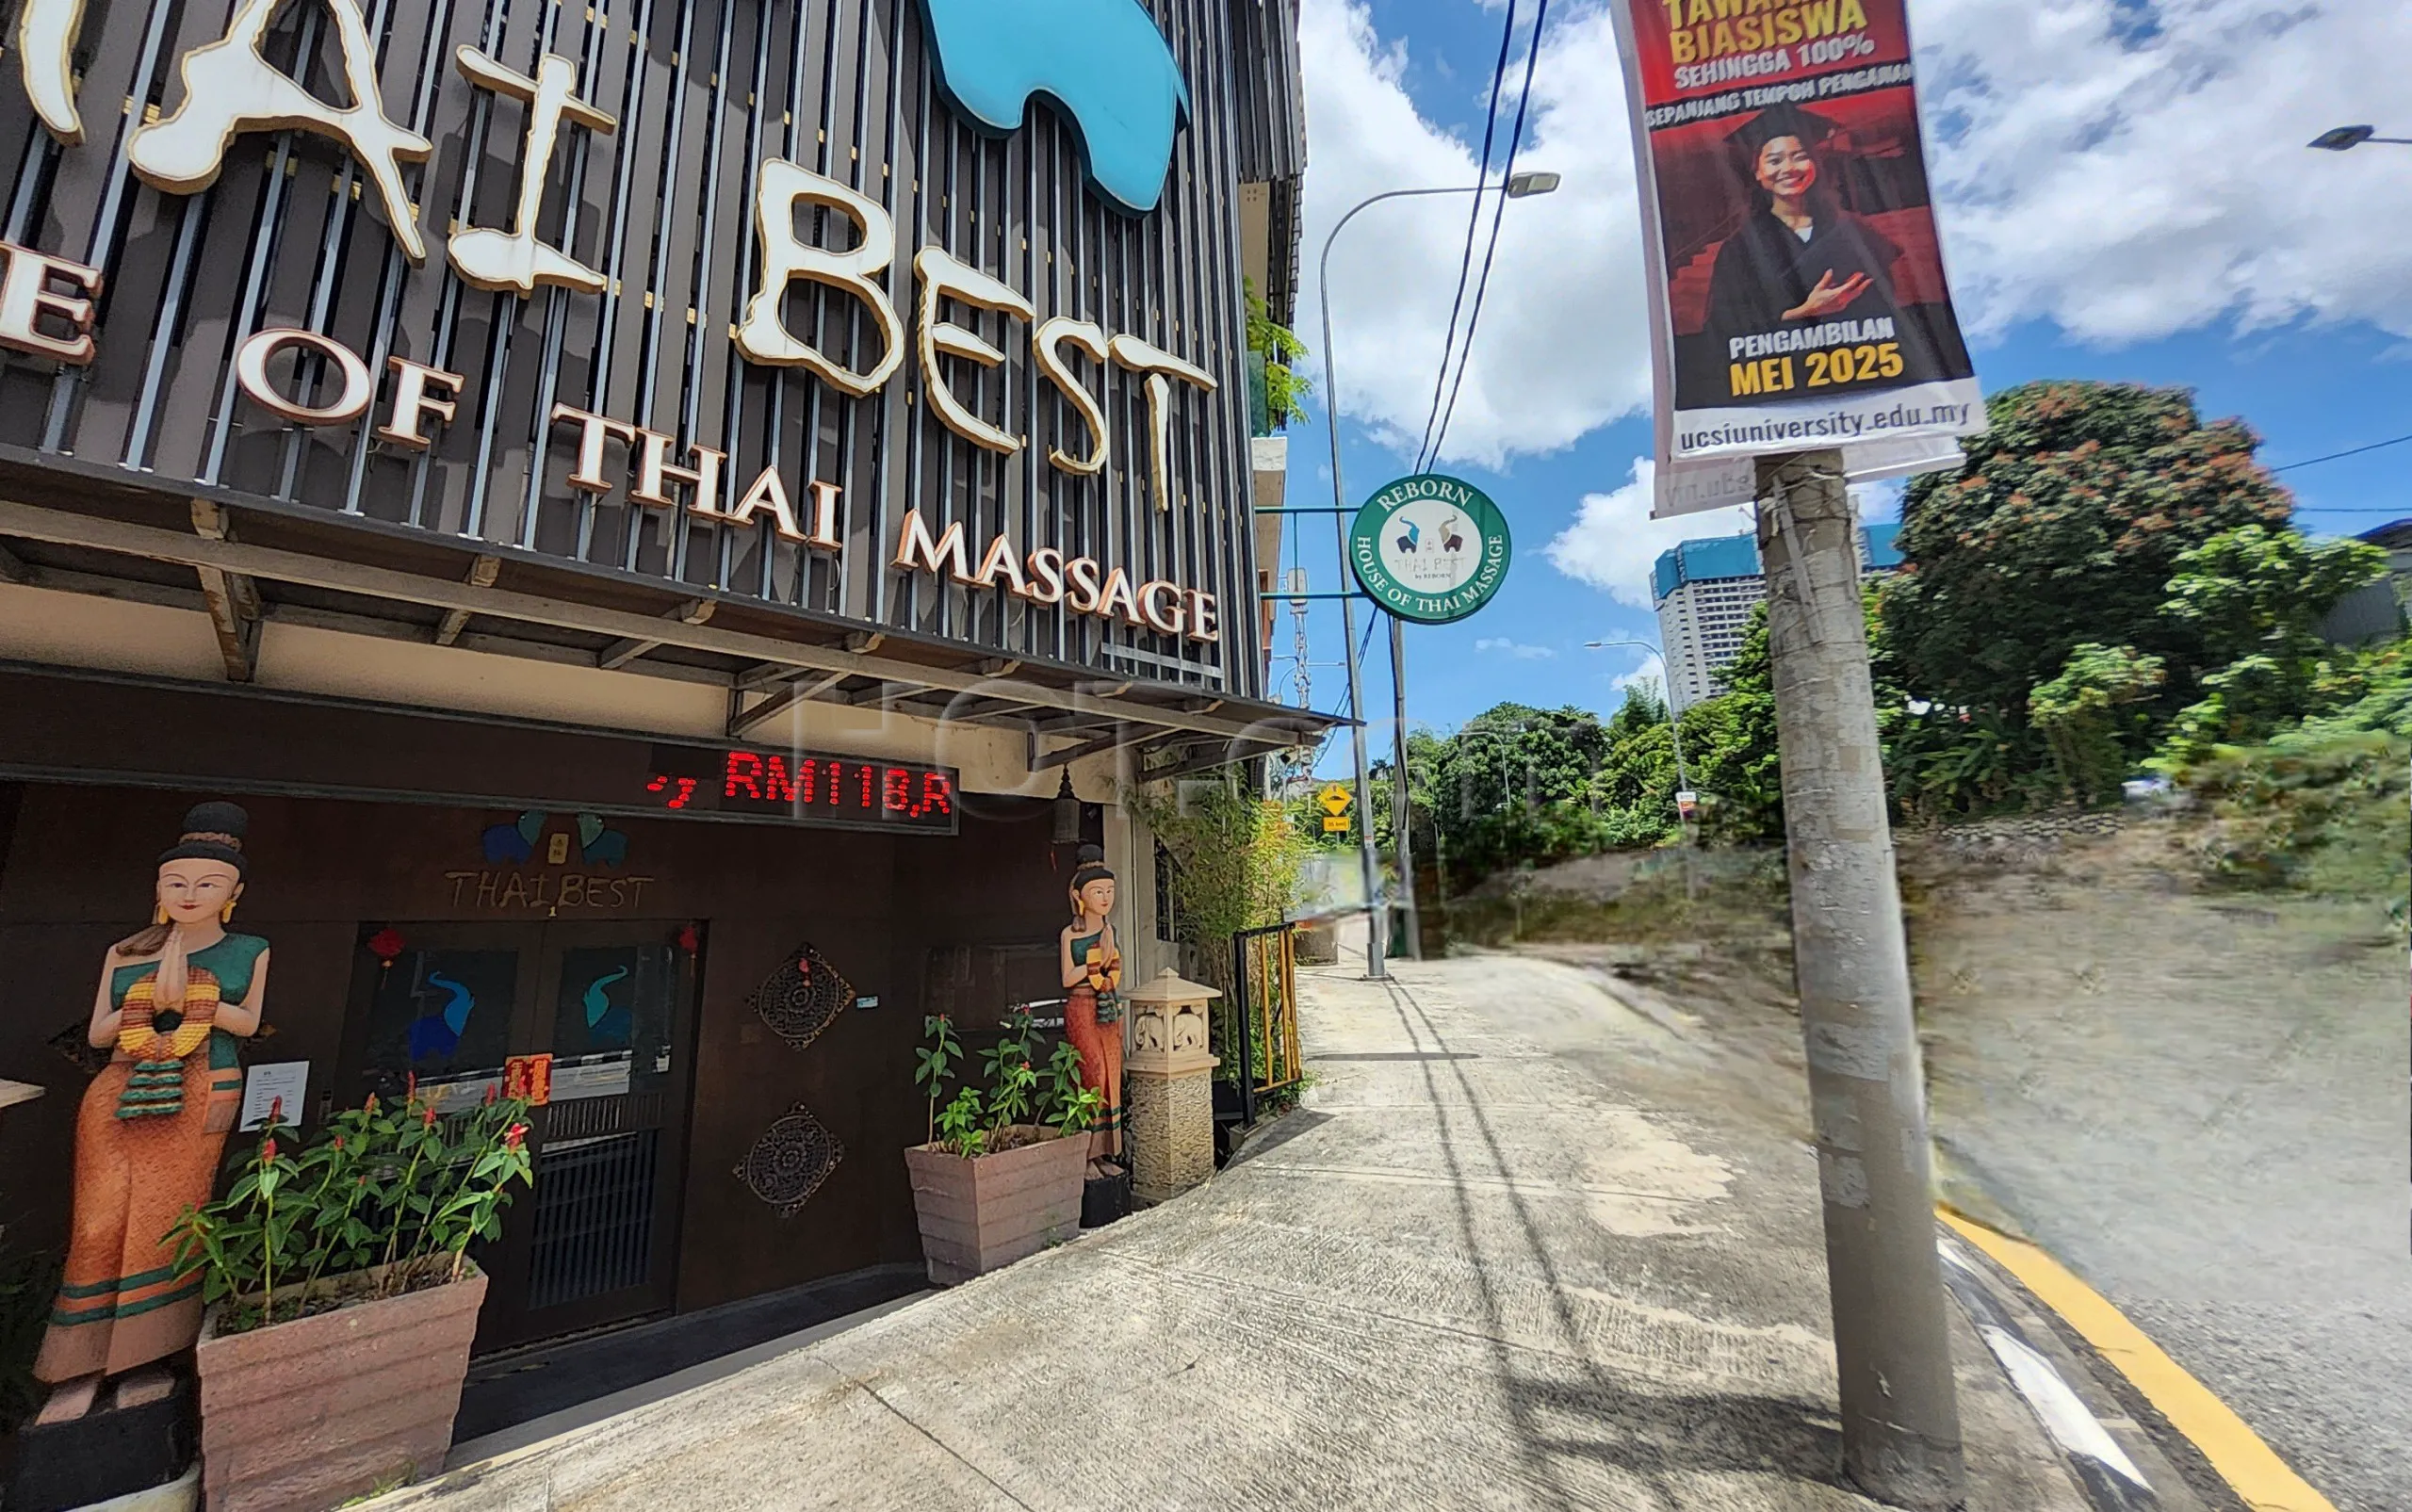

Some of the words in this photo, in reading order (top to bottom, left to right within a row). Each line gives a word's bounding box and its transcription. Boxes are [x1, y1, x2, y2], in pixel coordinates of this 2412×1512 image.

[1670, 1, 1868, 65] BIASISWA
[1674, 49, 1792, 90] SEHINGGA
[1797, 32, 1875, 68] 100%
[736, 157, 1216, 514] BEST
[1730, 317, 1896, 360] PENGAMBILAN
[1730, 356, 1795, 398] MEI
[1805, 342, 1904, 388] 2025
[1681, 402, 1971, 451] ucsiuniversity.edu.my
[236, 327, 464, 449] OF
[549, 401, 843, 553] THAI
[888, 507, 1219, 643] MASSAGE
[1377, 479, 1475, 512] REBORN
[1357, 536, 1390, 593] HOUSE
[1387, 587, 1412, 608] OF
[1416, 595, 1461, 613] THAI
[1460, 534, 1504, 604] MASSAGE
[444, 870, 550, 908] THAI
[558, 873, 655, 908] BEST
